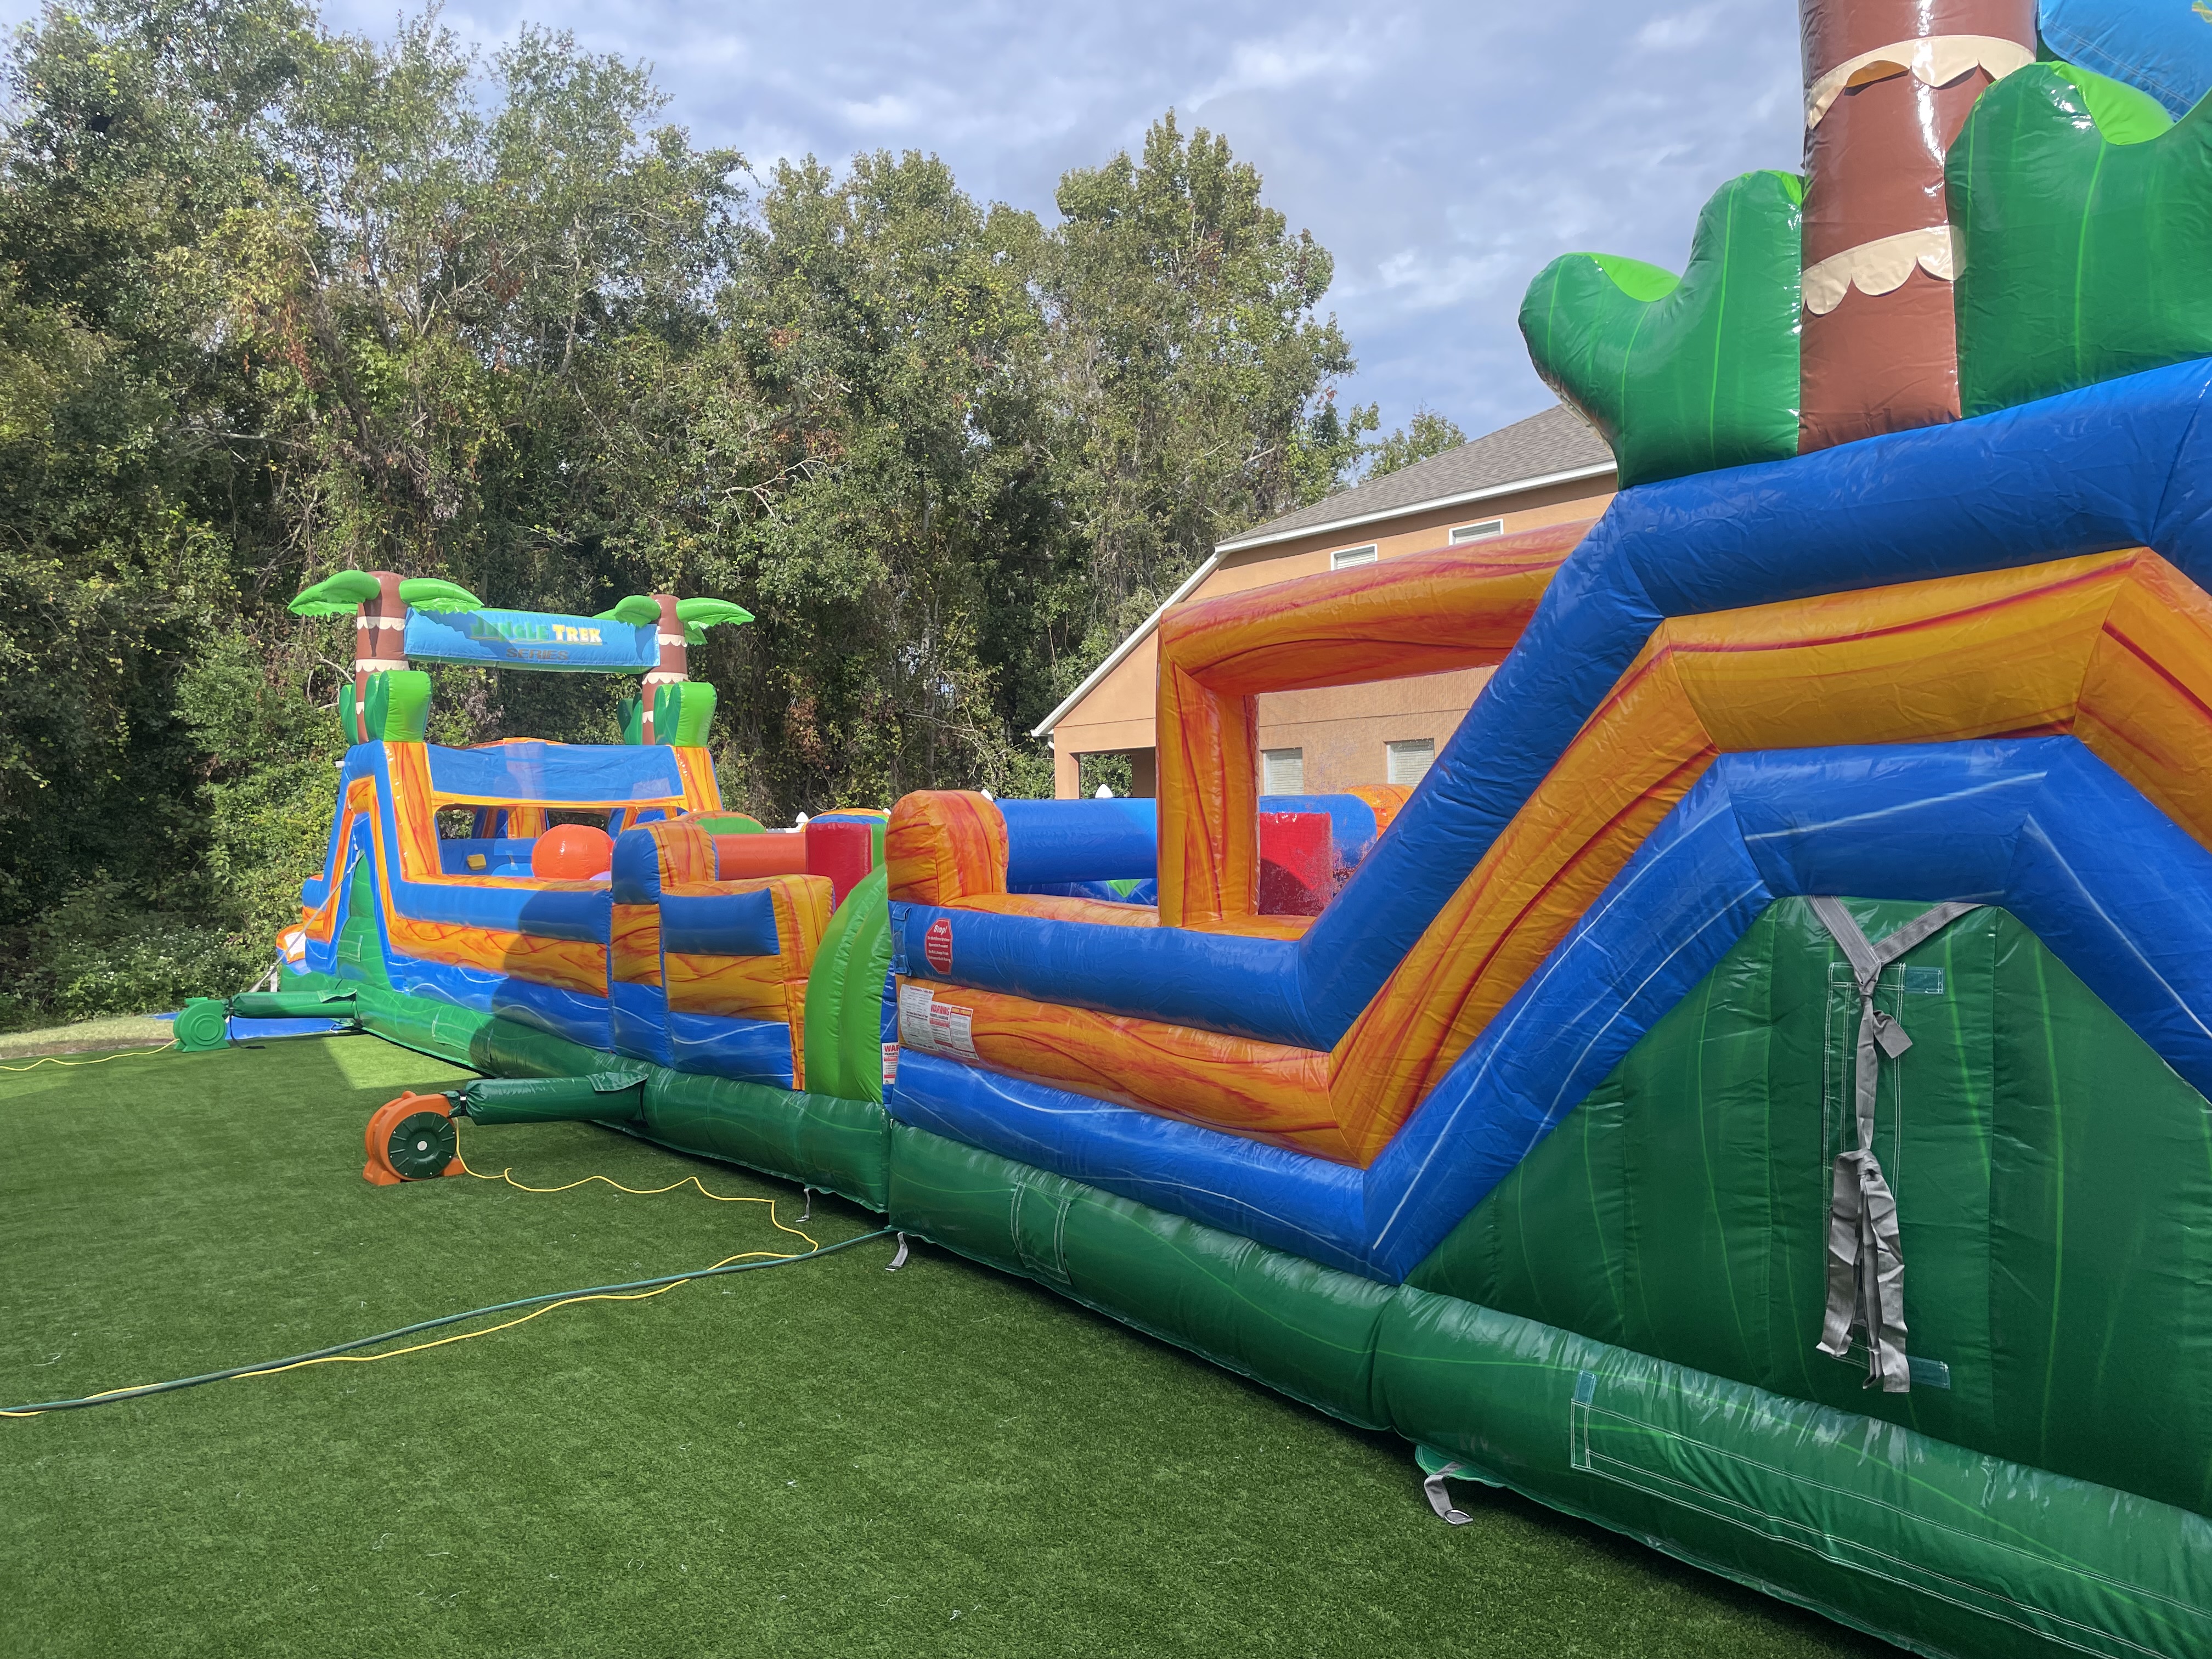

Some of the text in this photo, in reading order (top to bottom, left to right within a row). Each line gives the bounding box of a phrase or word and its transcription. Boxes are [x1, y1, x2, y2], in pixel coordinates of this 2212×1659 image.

[552, 624, 602, 642] TREK
[506, 647, 568, 660] SERIES
[933, 924, 948, 935] Stop!
